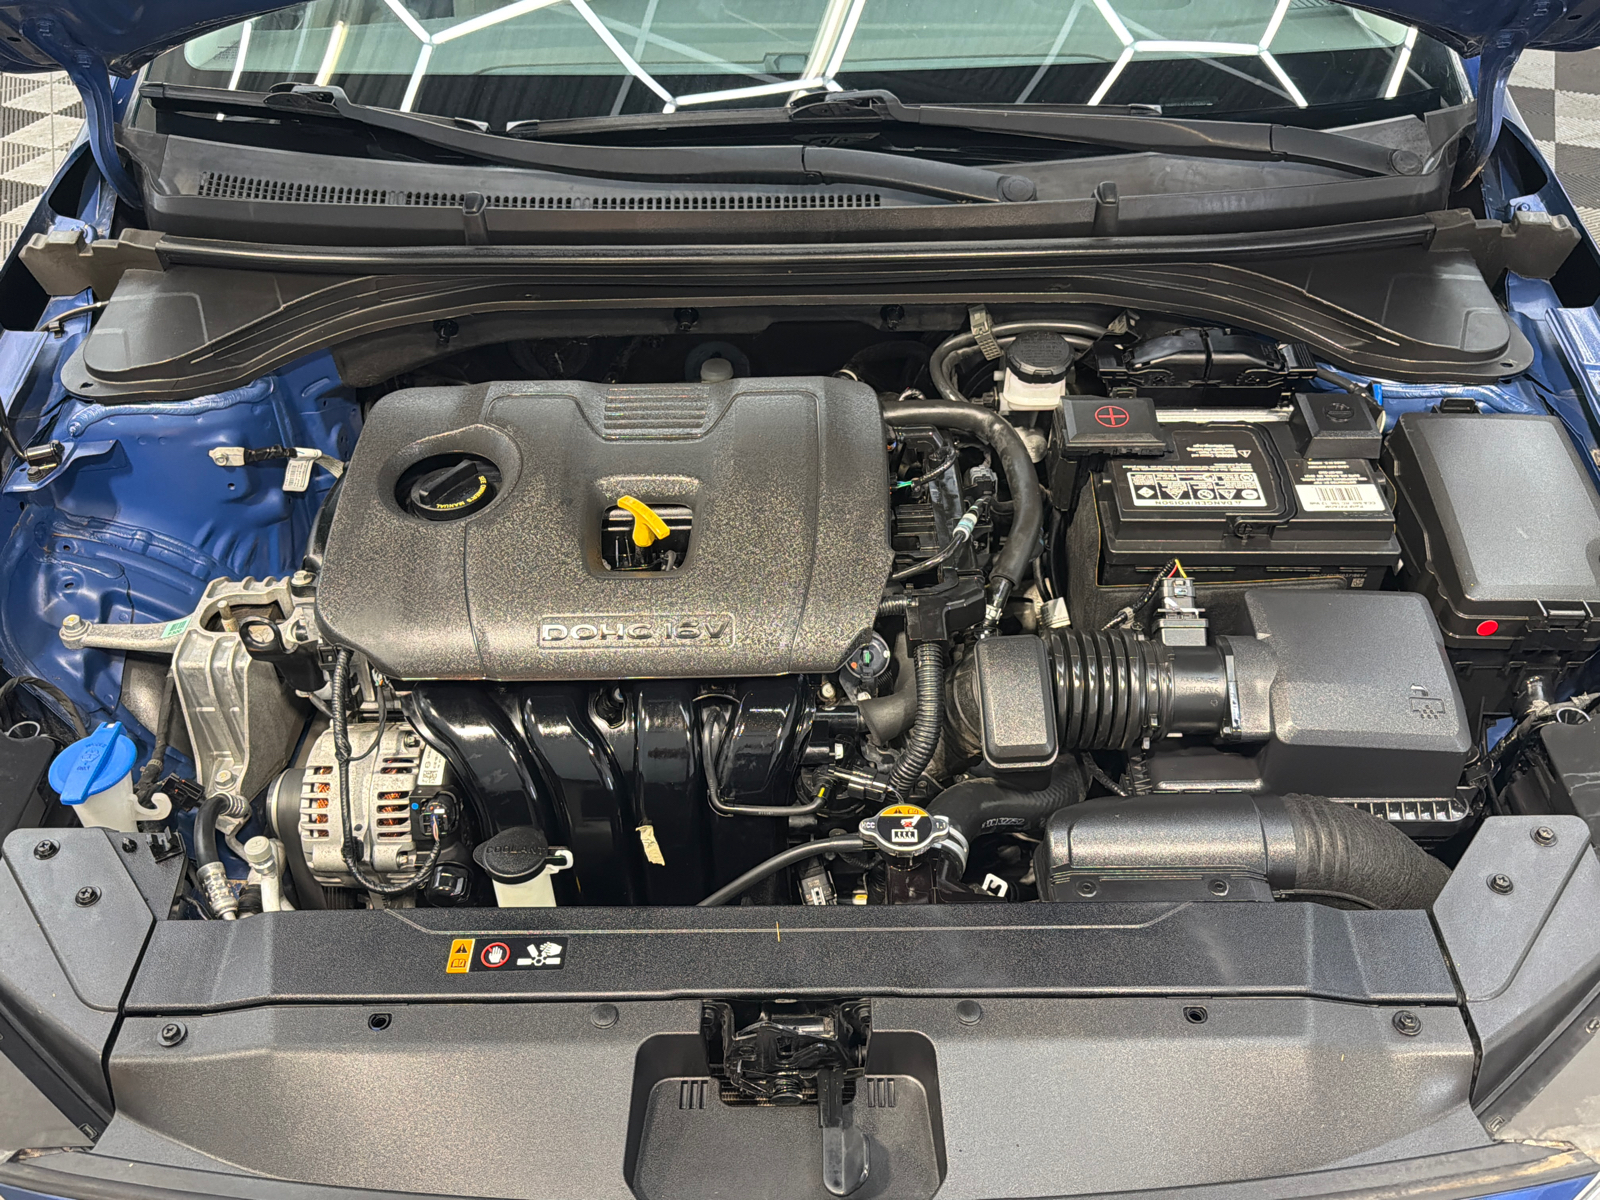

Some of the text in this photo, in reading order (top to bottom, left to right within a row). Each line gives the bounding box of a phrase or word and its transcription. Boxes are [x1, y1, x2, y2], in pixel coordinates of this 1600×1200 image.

[478, 475, 487, 484] SEE
[436, 501, 465, 509] MANUAL
[542, 620, 730, 641] DOHC 16V
[486, 845, 547, 856] COOLANT
